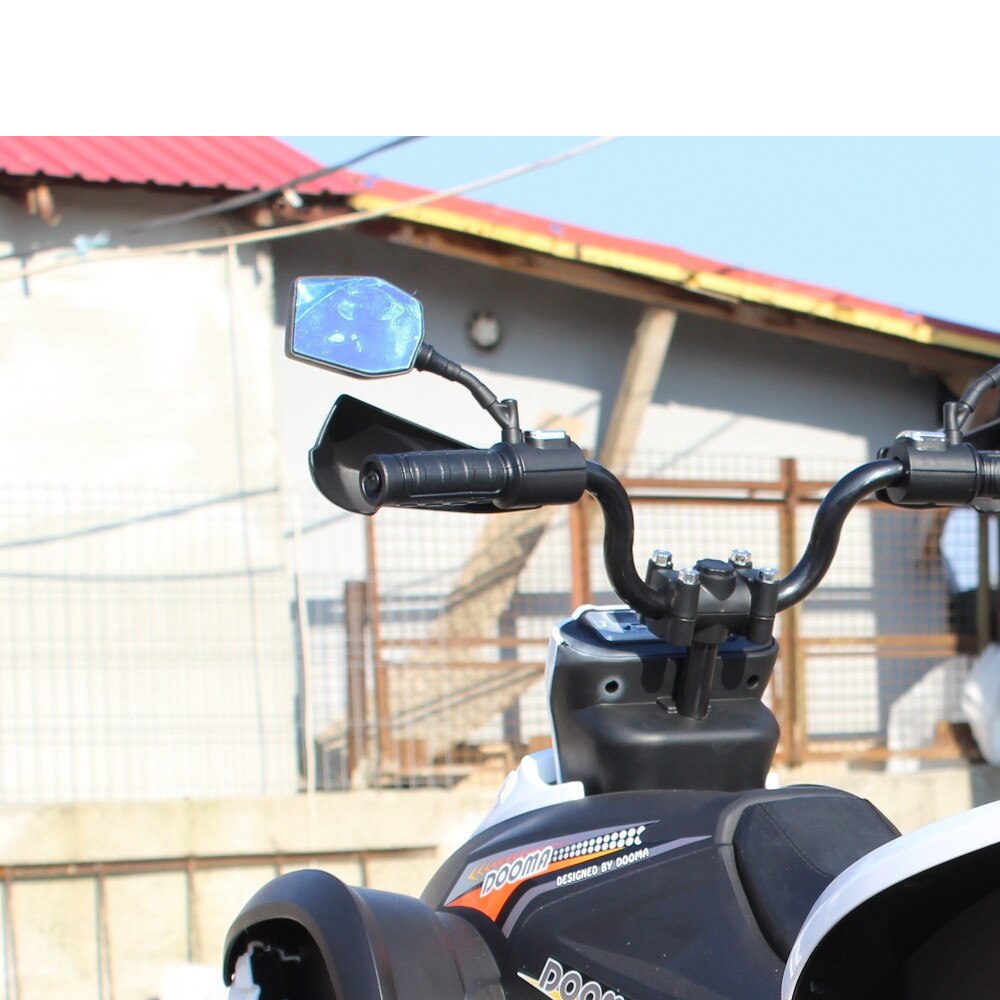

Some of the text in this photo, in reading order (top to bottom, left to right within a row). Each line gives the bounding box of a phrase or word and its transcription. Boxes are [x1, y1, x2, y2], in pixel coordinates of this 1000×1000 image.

[480, 846, 553, 898] DOOMA
[556, 847, 650, 887] DESIGNED BY DOOMA
